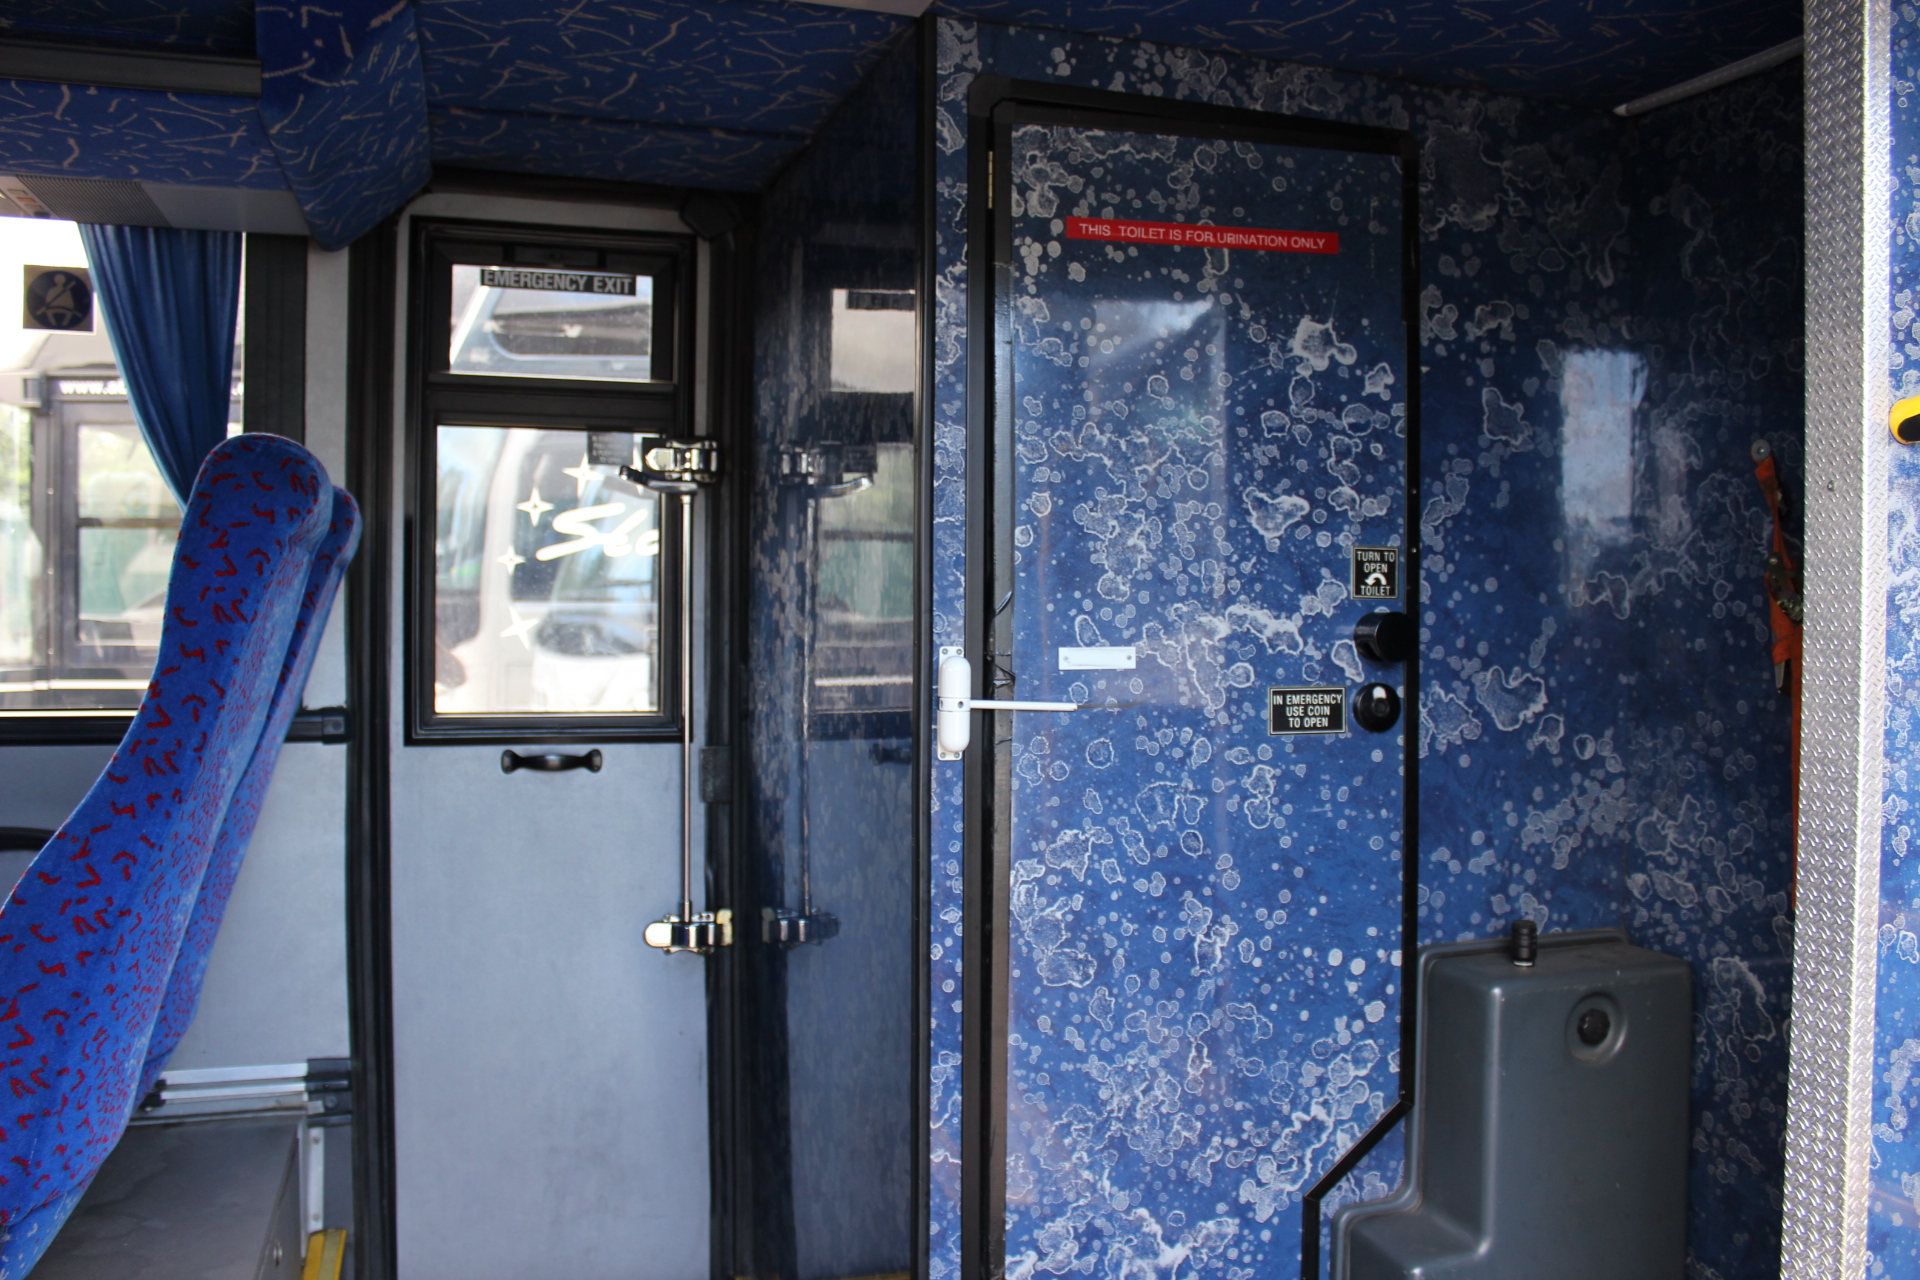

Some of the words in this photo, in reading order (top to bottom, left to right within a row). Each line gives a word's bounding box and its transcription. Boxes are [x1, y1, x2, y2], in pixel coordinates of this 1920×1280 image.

[1079, 223, 1111, 237] THIS
[1118, 226, 1166, 240] TOILET
[1169, 229, 1182, 241] IS
[1185, 230, 1214, 243] FOR
[1217, 232, 1288, 247] URINATION
[1291, 236, 1326, 249] ONLY
[483, 269, 588, 291] EMERGENCY
[593, 276, 632, 294] EXIT
[1357, 551, 1381, 561] TURN
[1384, 551, 1395, 562] TO
[1363, 562, 1388, 573] OPEN
[1360, 585, 1391, 596] TOILET
[1273, 695, 1283, 705] IN
[1286, 694, 1342, 705] EMERGENCY
[1286, 706, 1305, 717] USE
[1307, 705, 1331, 716] COIN
[1288, 717, 1301, 728] TO
[1303, 717, 1329, 728] OPEN
